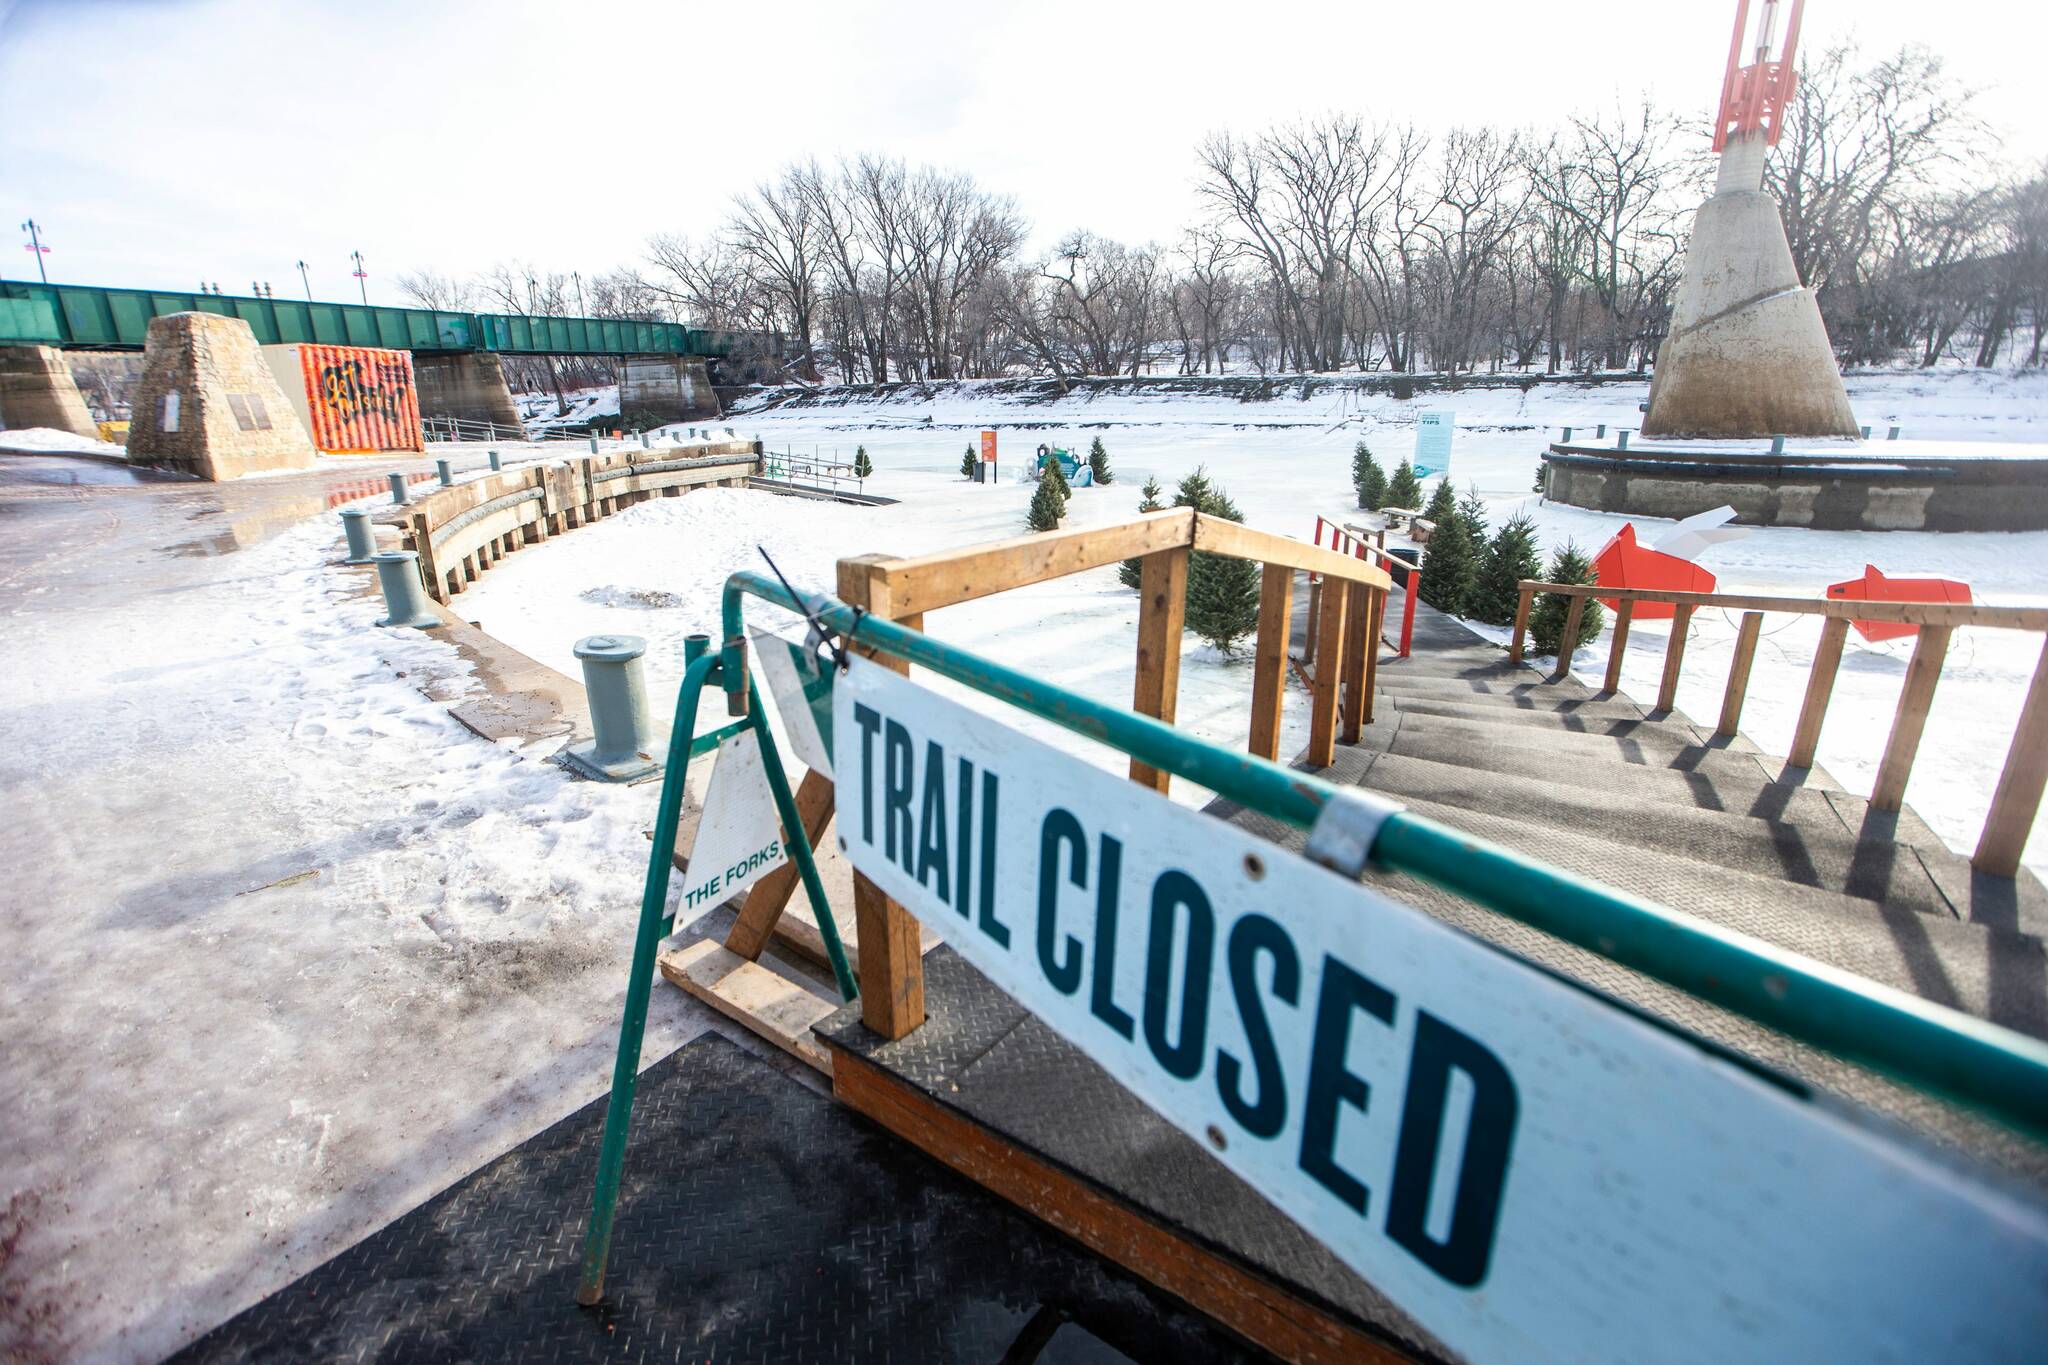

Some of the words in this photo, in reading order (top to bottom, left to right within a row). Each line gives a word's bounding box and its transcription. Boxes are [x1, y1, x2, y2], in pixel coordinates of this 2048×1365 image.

[685, 876, 720, 909] THE
[726, 840, 779, 887] FORKS
[854, 702, 1010, 949] TRAIL
[1036, 807, 1520, 1288] CLOSED
